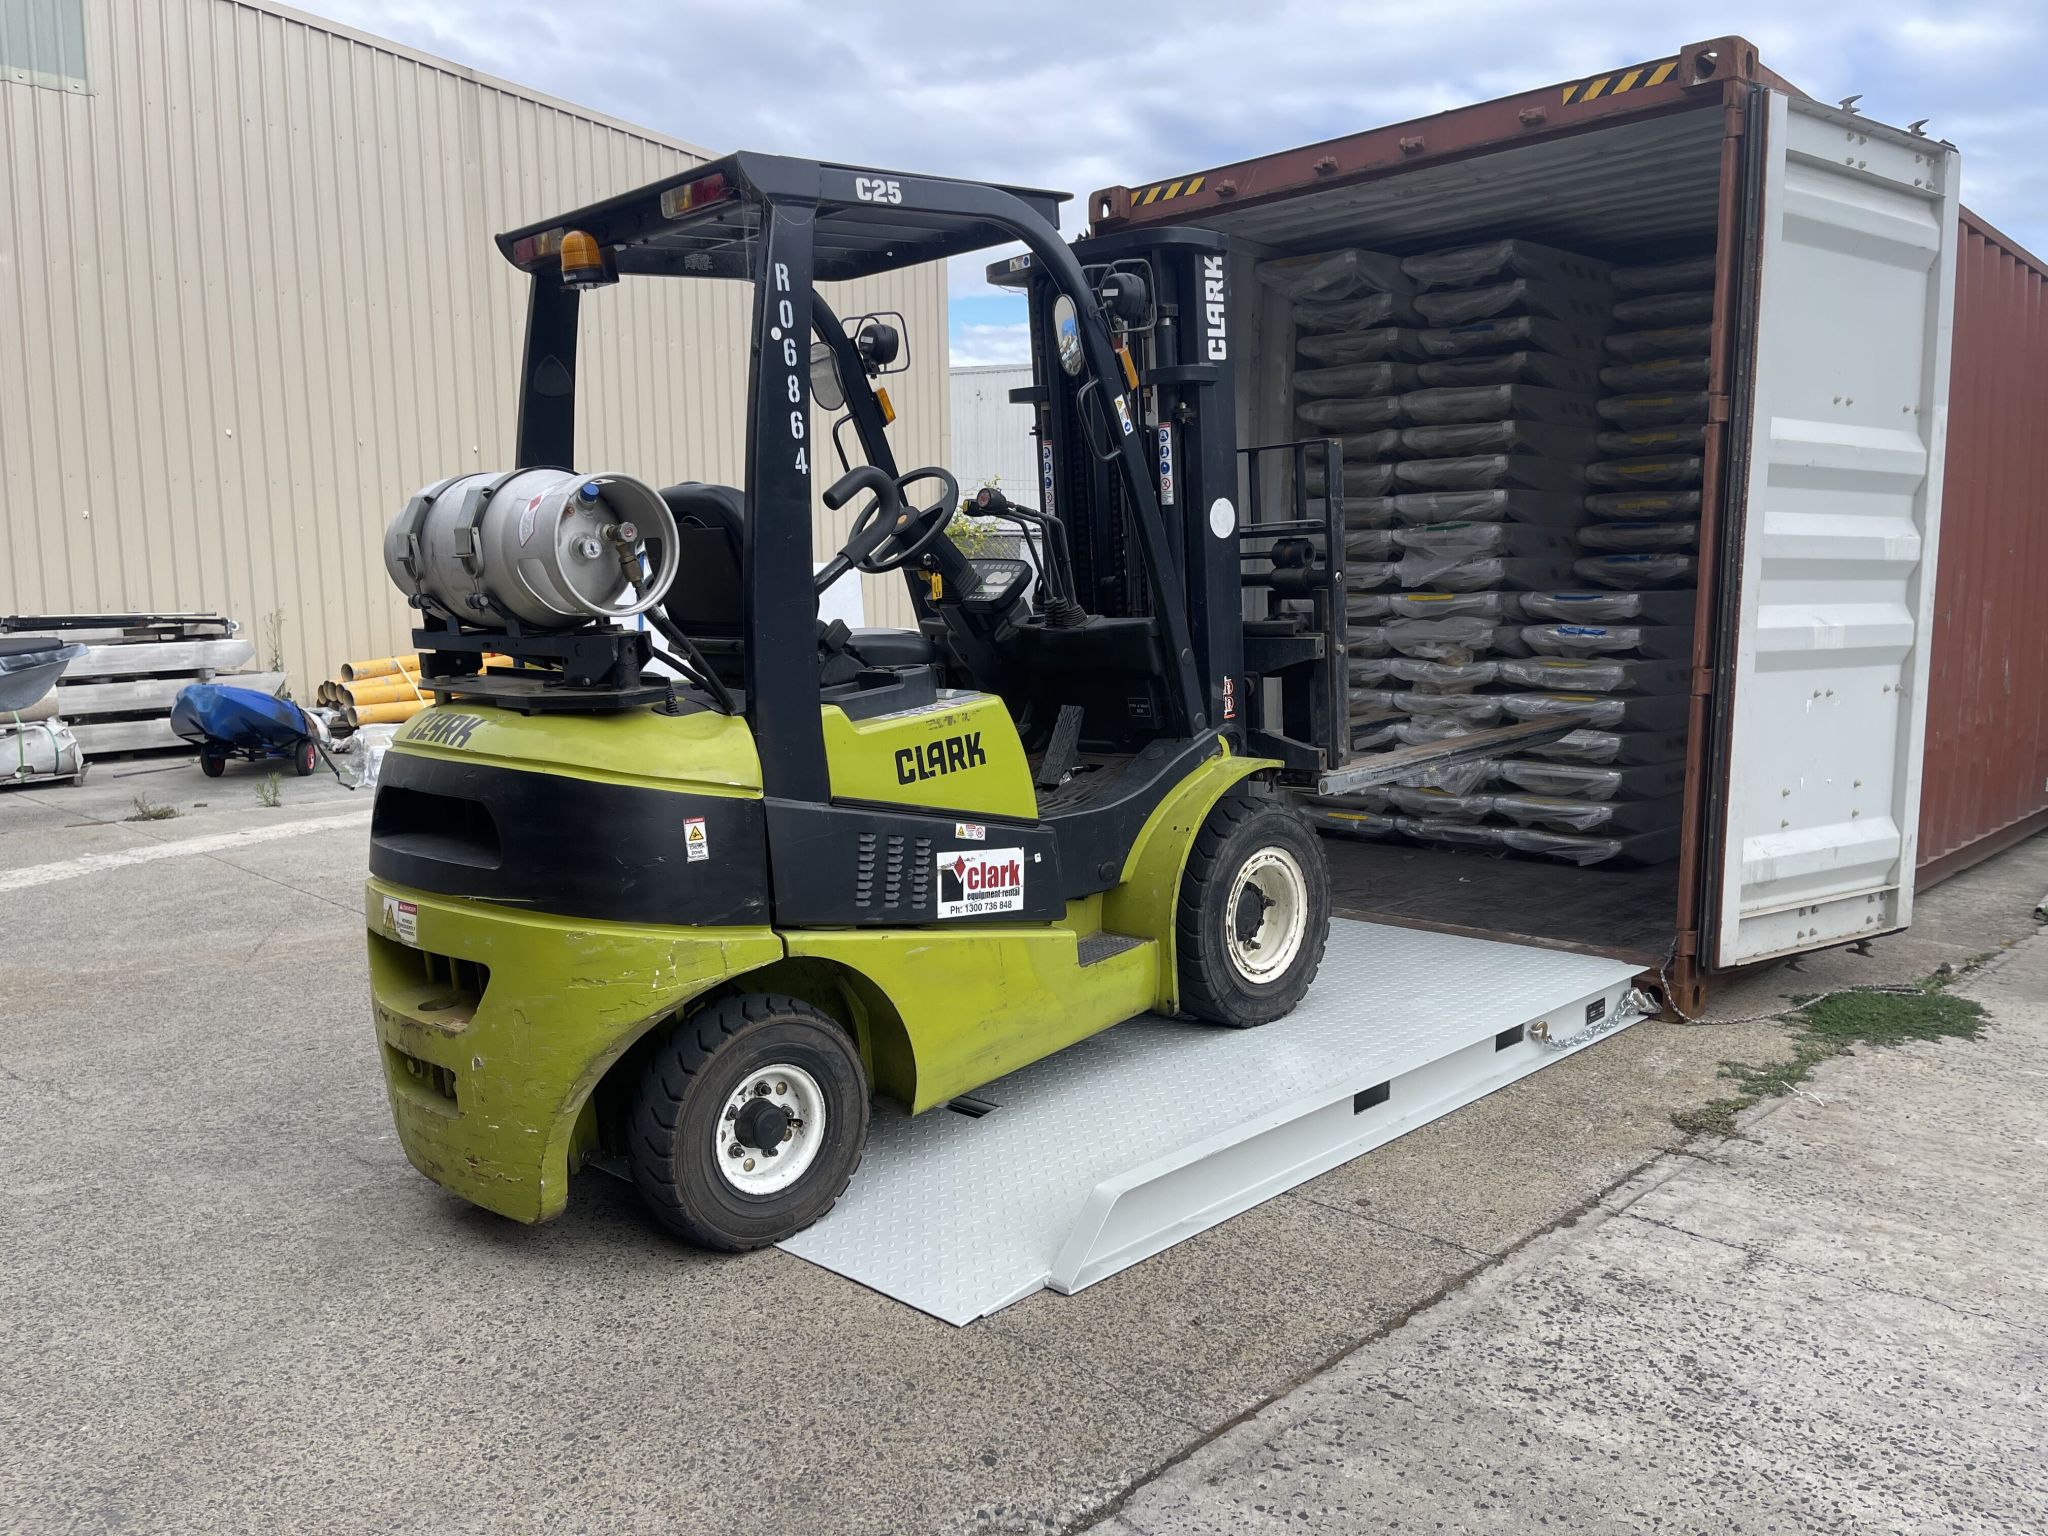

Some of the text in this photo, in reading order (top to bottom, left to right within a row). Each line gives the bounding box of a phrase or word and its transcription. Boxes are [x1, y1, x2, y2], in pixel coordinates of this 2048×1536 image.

[855, 177, 902, 204] C25
[1204, 256, 1227, 361] CLARK
[406, 712, 488, 749] CLARK
[894, 731, 987, 786] CLARK
[966, 859, 1021, 890] clark
[950, 900, 1013, 915] Ph: 1300 736 848
